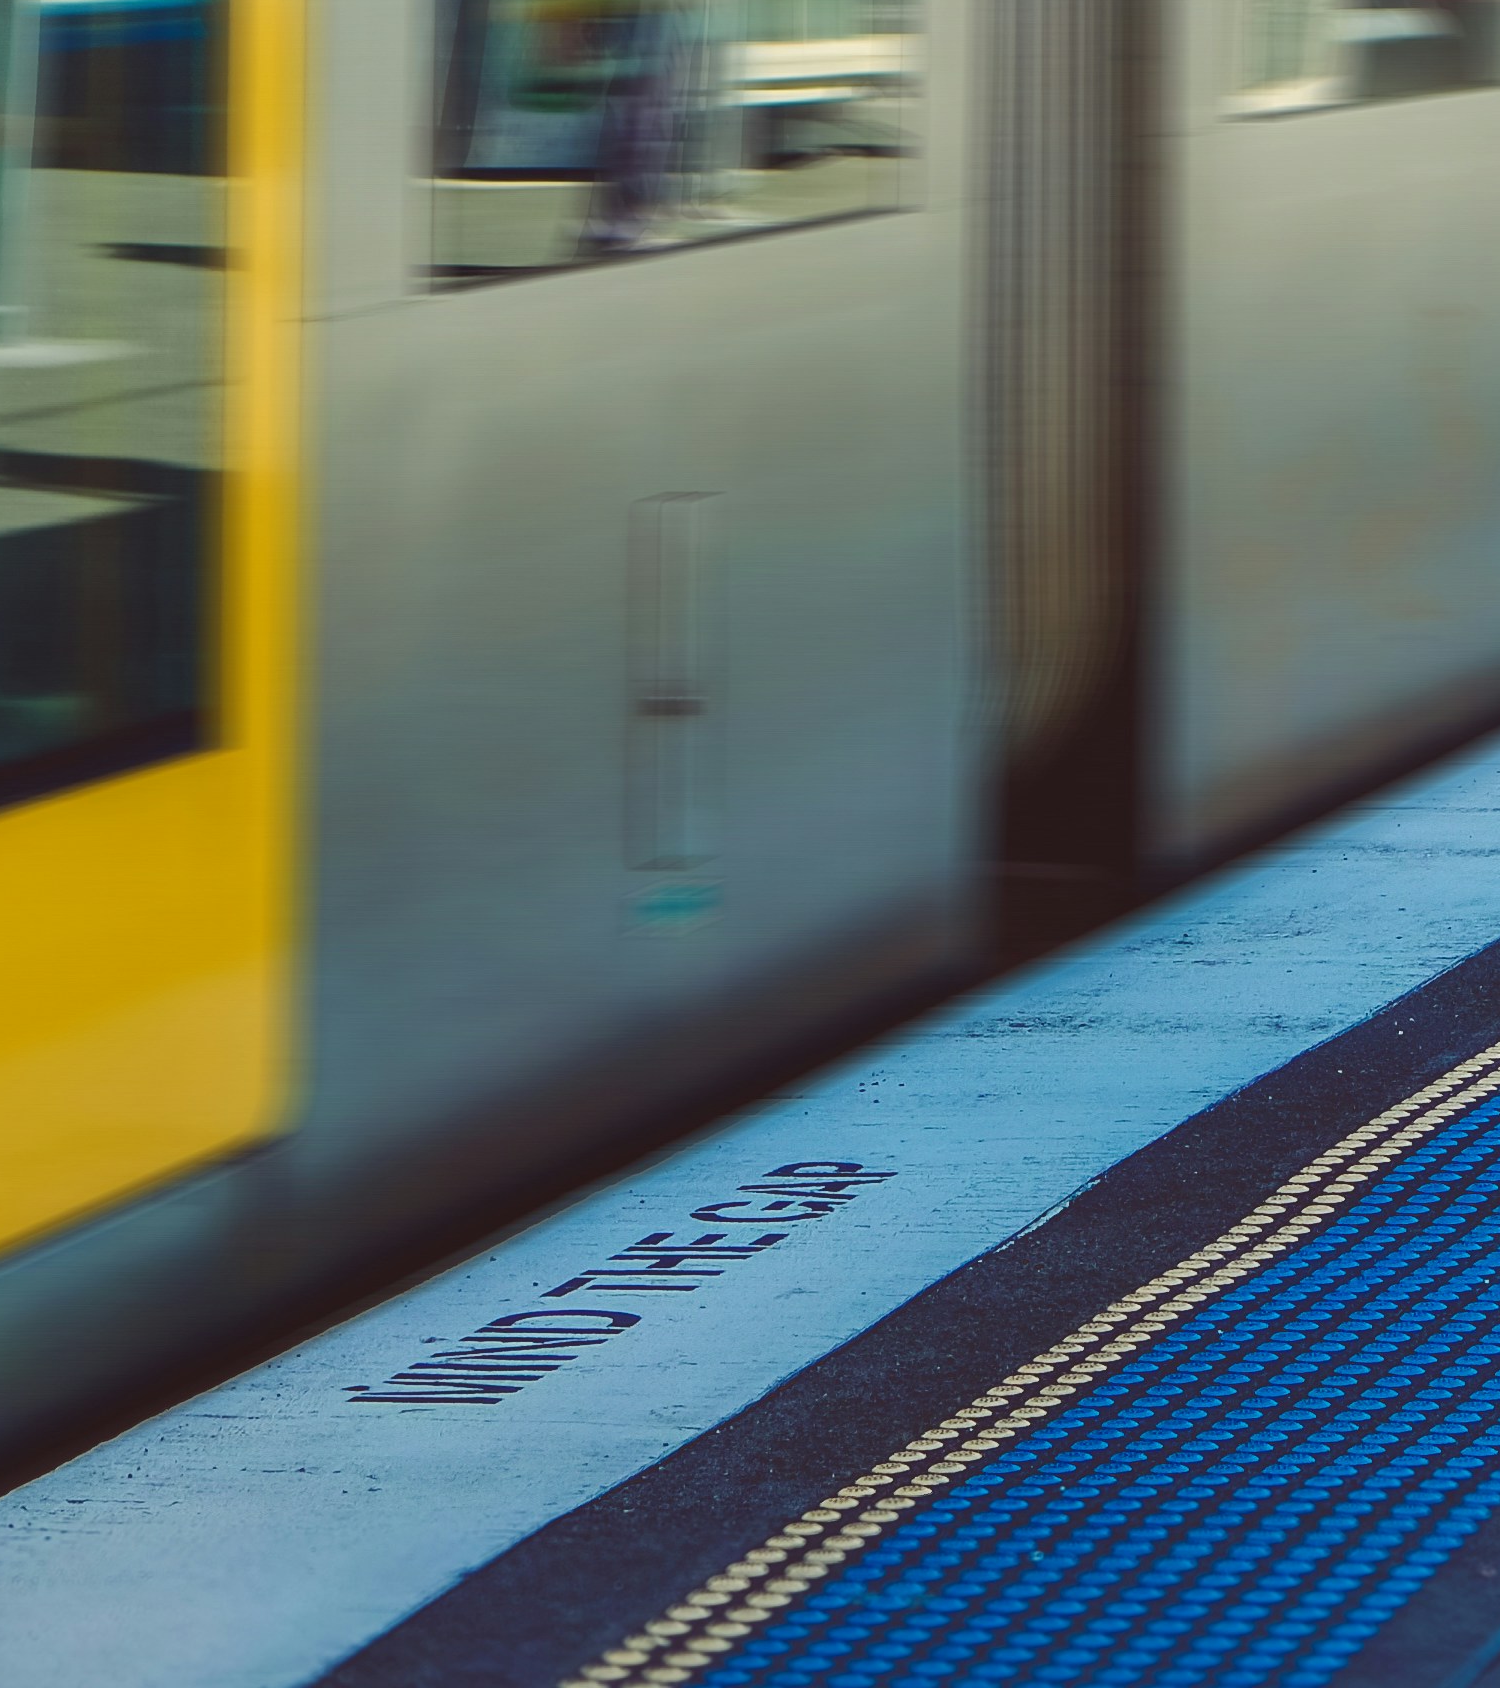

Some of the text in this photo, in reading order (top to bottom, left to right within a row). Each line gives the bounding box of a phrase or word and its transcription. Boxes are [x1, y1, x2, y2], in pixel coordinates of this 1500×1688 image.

[342, 1160, 898, 1405] MIND THE GAP
